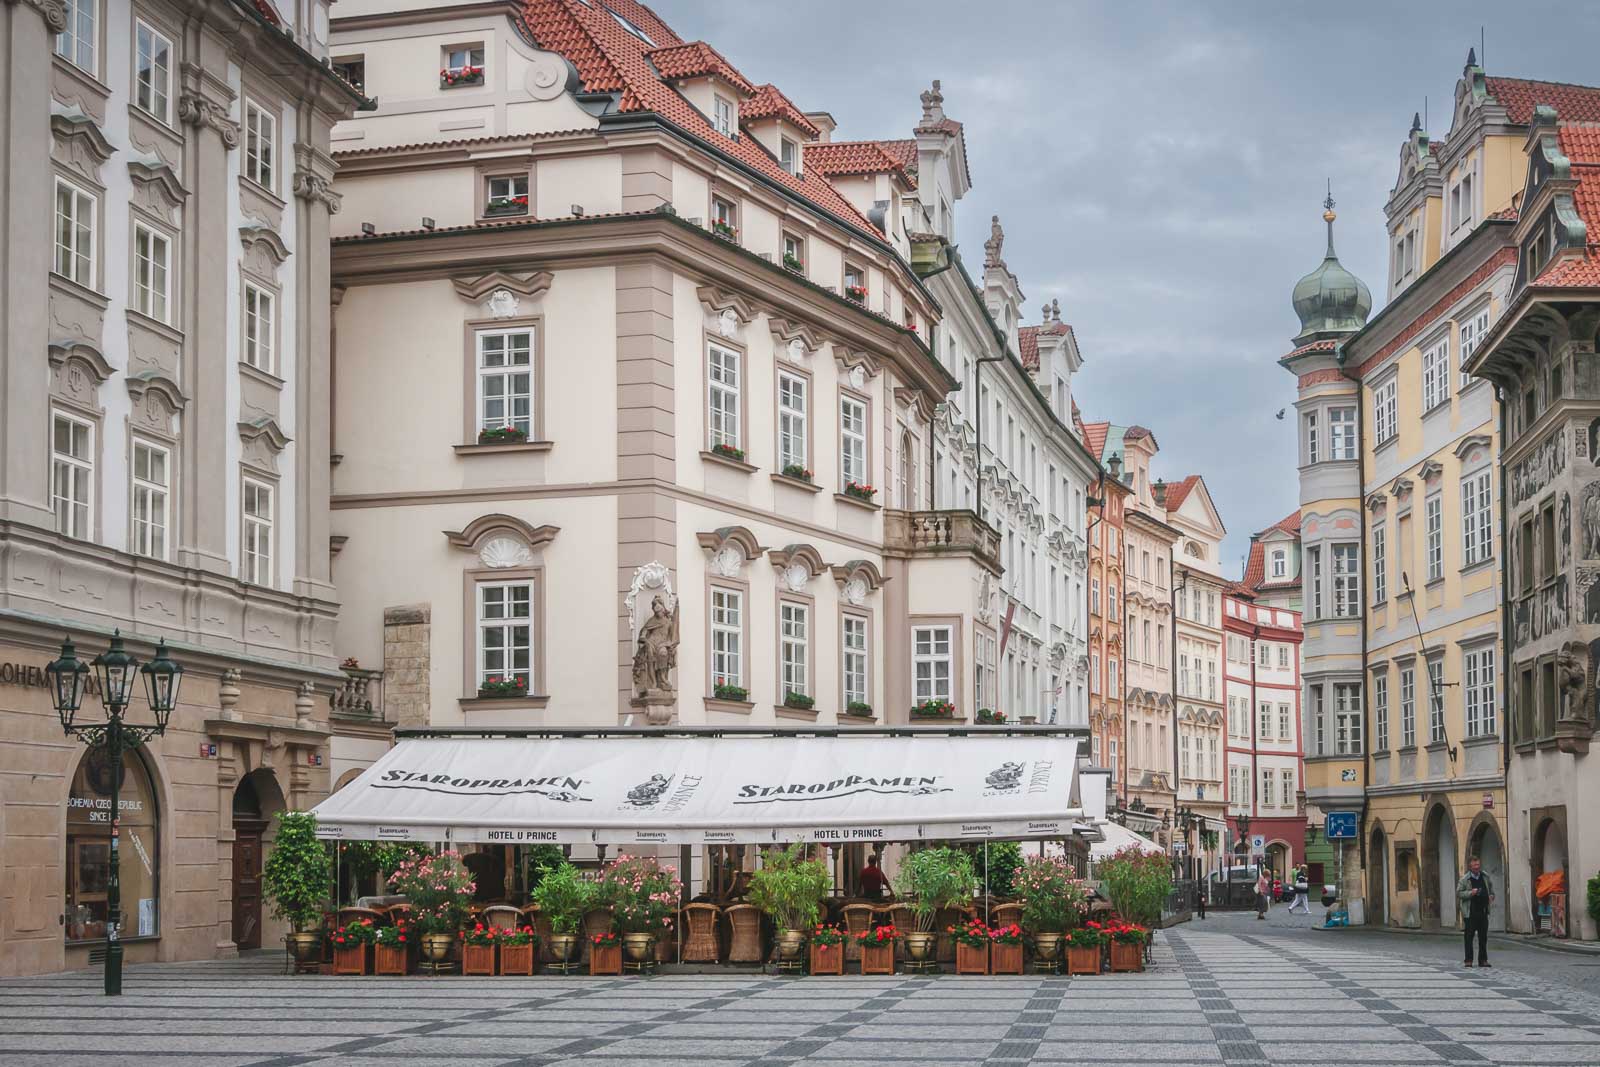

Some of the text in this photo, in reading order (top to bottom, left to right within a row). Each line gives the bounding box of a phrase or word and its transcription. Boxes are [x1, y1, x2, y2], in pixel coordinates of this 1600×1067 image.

[381, 769, 583, 791] STAROPRAMEN
[738, 774, 936, 798] STAROPRAMEN
[89, 811, 107, 822] SINCE
[488, 831, 557, 841] HOTEL U PRINCE
[814, 828, 883, 839] HOTEL U PRINCE
